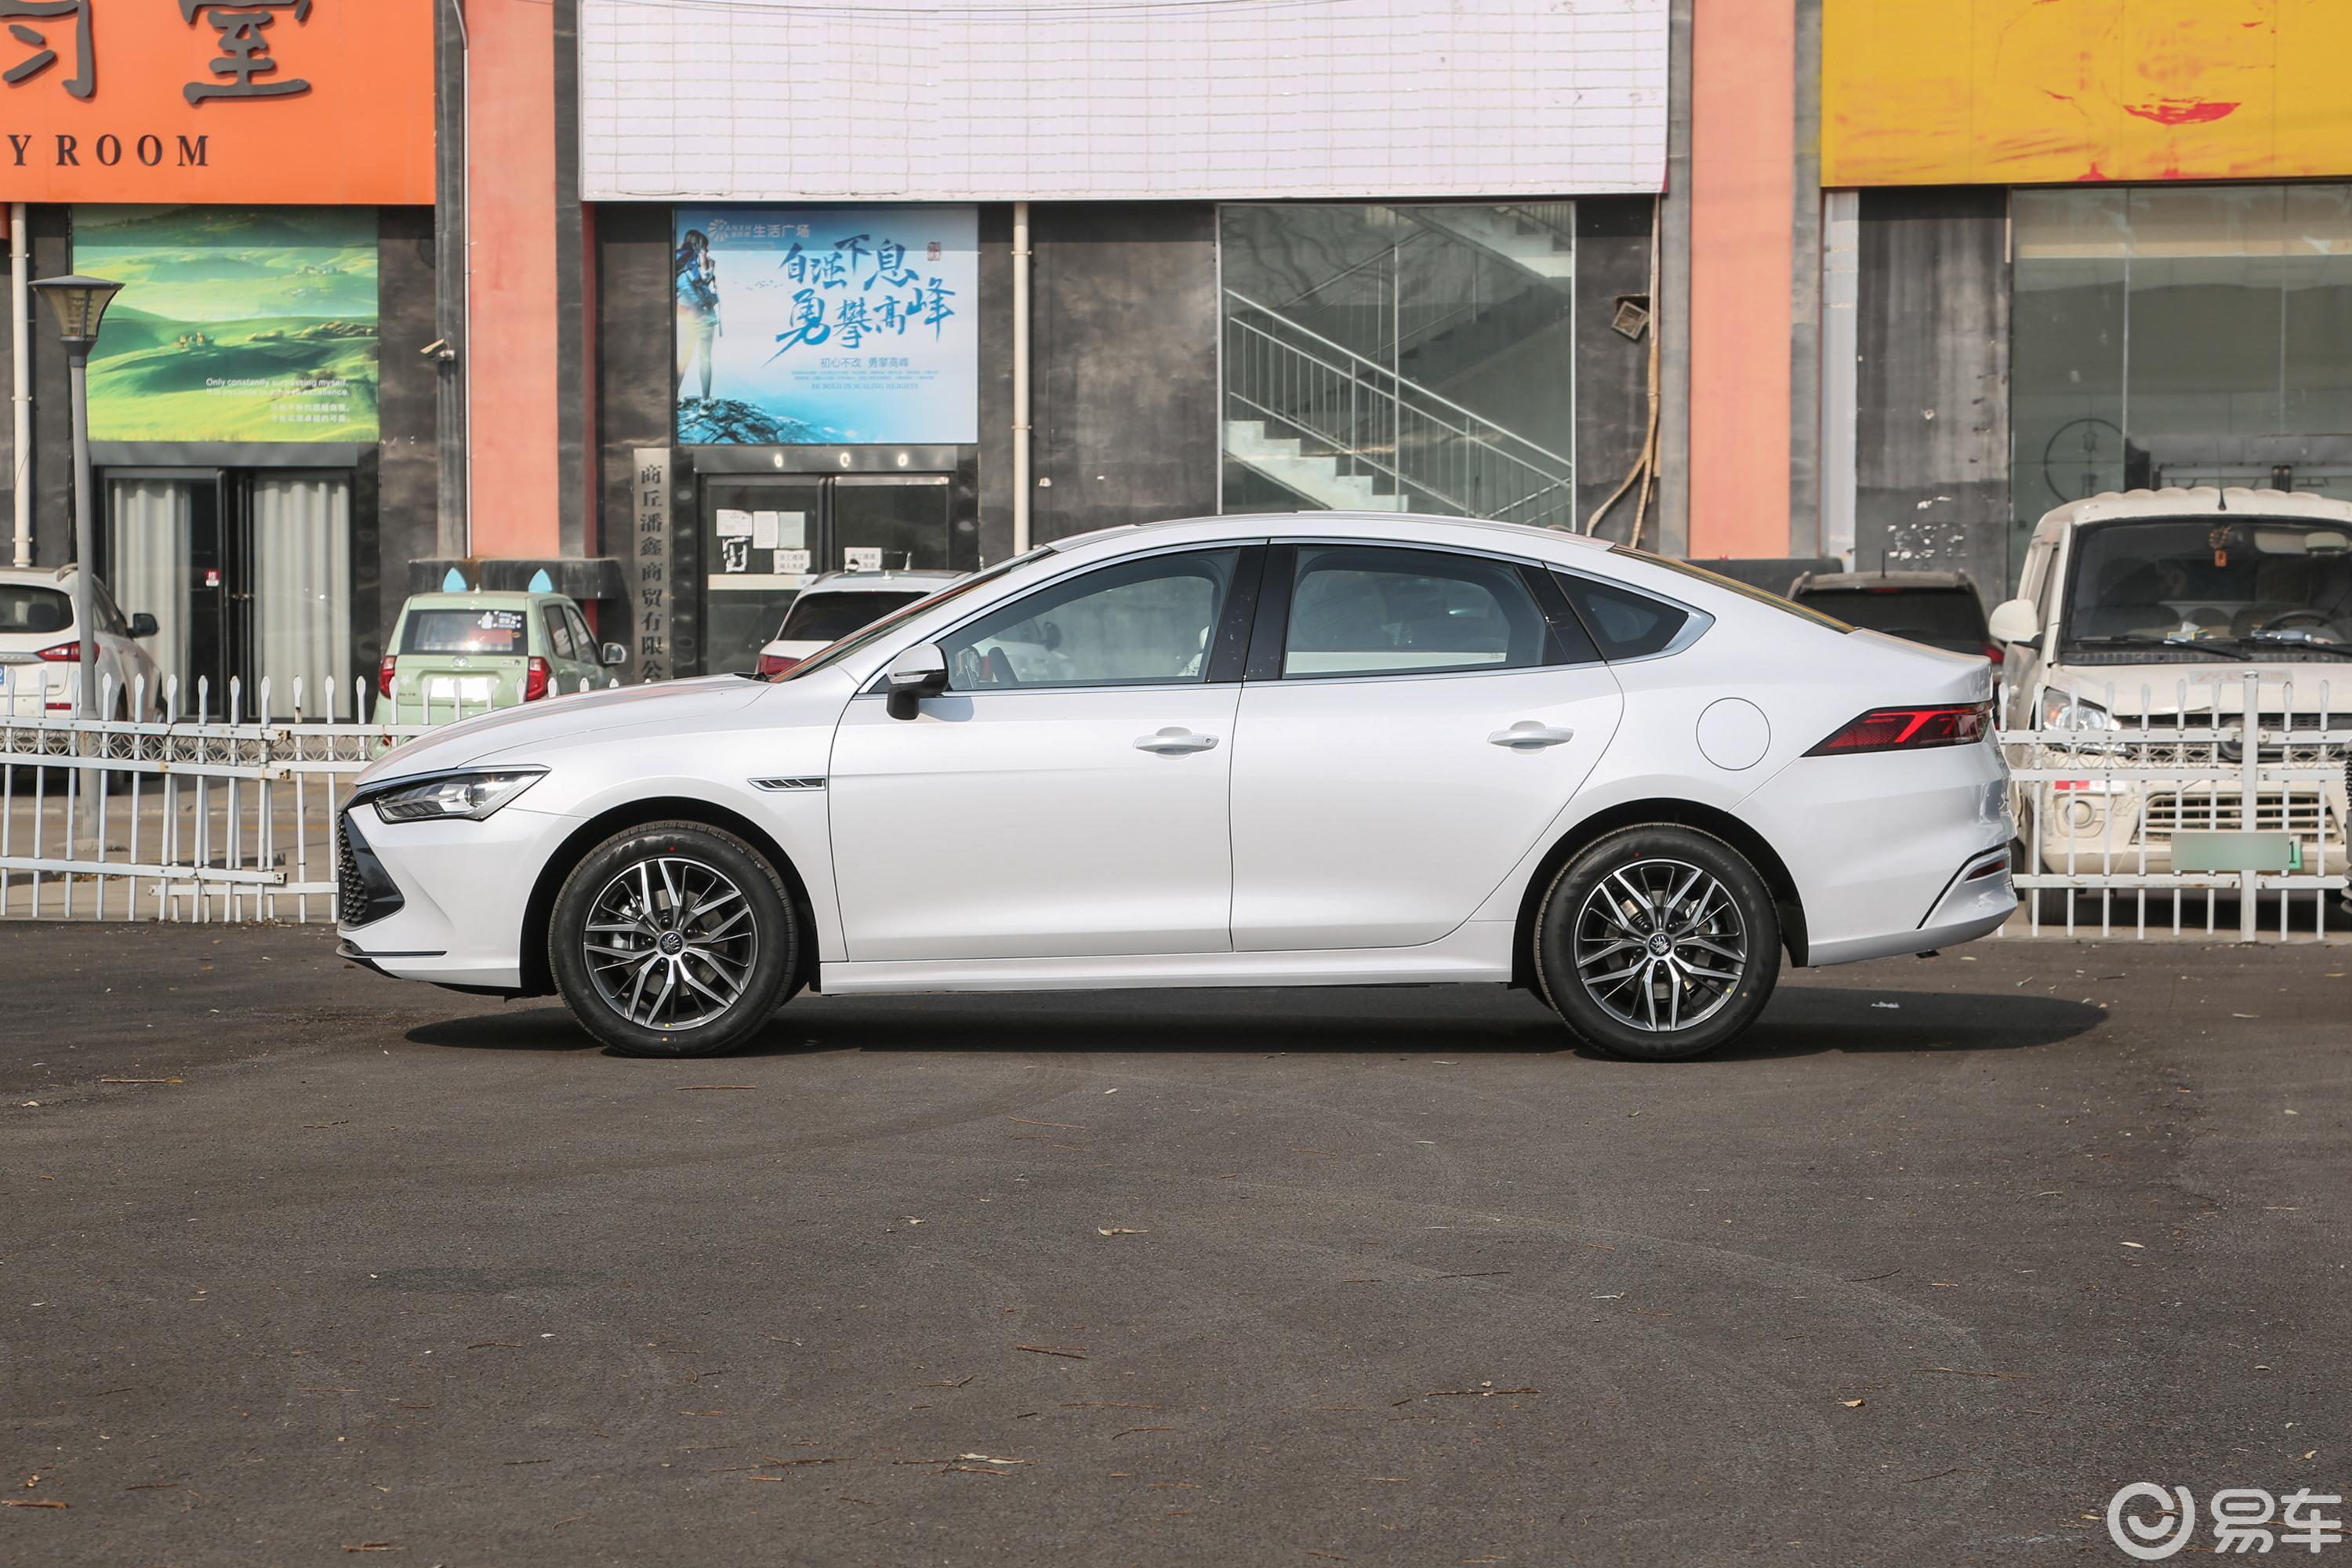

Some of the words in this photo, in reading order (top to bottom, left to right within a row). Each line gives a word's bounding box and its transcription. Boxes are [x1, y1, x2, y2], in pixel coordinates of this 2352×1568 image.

[56, 134, 209, 167] ROOM
[779, 234, 920, 291] 自强不息
[760, 277, 956, 368] 勇攀高峰
[820, 358, 862, 368] 初心不改
[868, 358, 909, 368] 勇攀高峰
[205, 378, 225, 387] Only
[227, 378, 269, 387] constantly
